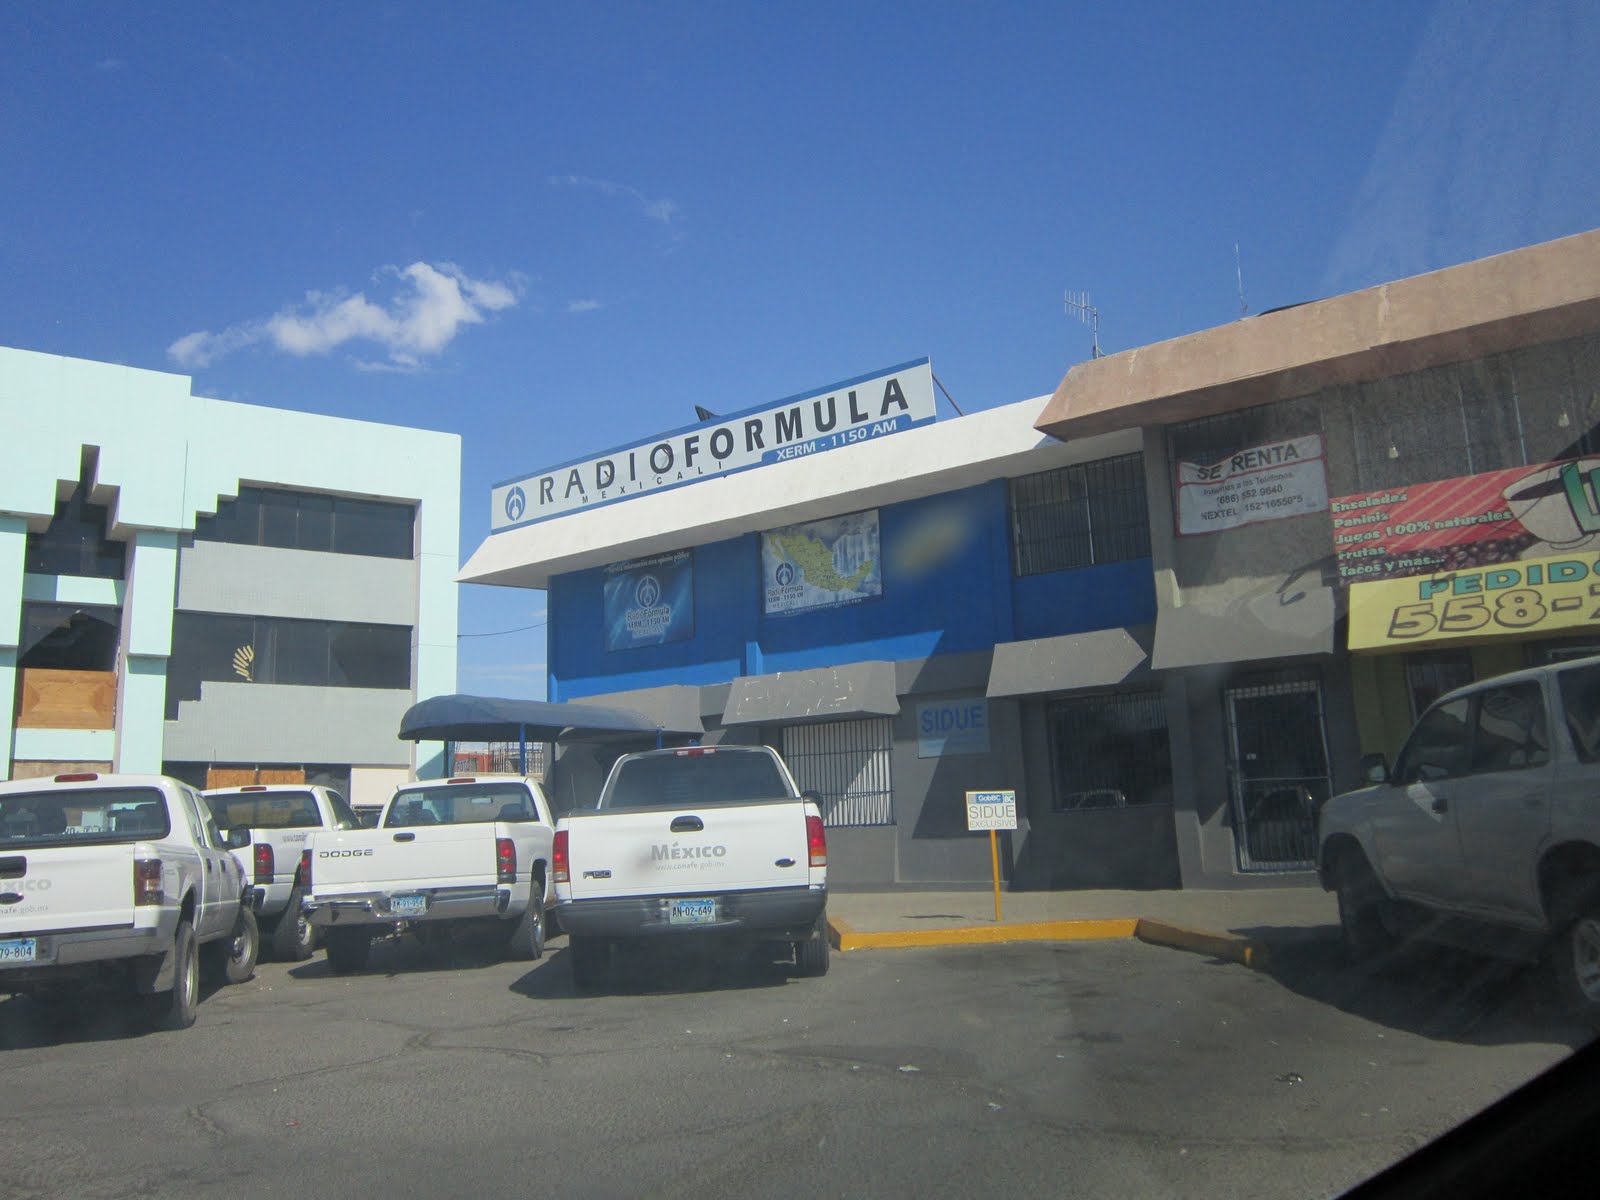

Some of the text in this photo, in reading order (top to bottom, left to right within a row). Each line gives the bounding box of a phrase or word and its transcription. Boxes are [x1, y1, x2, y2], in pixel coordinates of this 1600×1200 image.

[540, 378, 909, 505] RADIOFORMULA
[776, 441, 816, 461] XERM
[831, 427, 867, 446] 1150
[872, 418, 897, 436] AM
[1197, 443, 1299, 480] SE RENTA
[582, 461, 722, 504] MEXICALI
[1201, 507, 1238, 521] NEXTEL
[1333, 511, 1390, 529] Paninis
[1335, 510, 1513, 546] Jugos 100% naturales
[1338, 546, 1386, 560] Frutas
[1339, 563, 1382, 577] Tacos
[1384, 560, 1395, 571] y
[1419, 559, 1600, 600] PEDID
[1387, 583, 1600, 638] 558-
[921, 704, 985, 734] SIDUE
[978, 794, 1001, 802] GobBC
[969, 805, 1015, 819] SIDUE
[970, 820, 1016, 828] EXCLUSIVO
[319, 849, 374, 859] DODGE
[672, 905, 712, 918] AN-02-649
